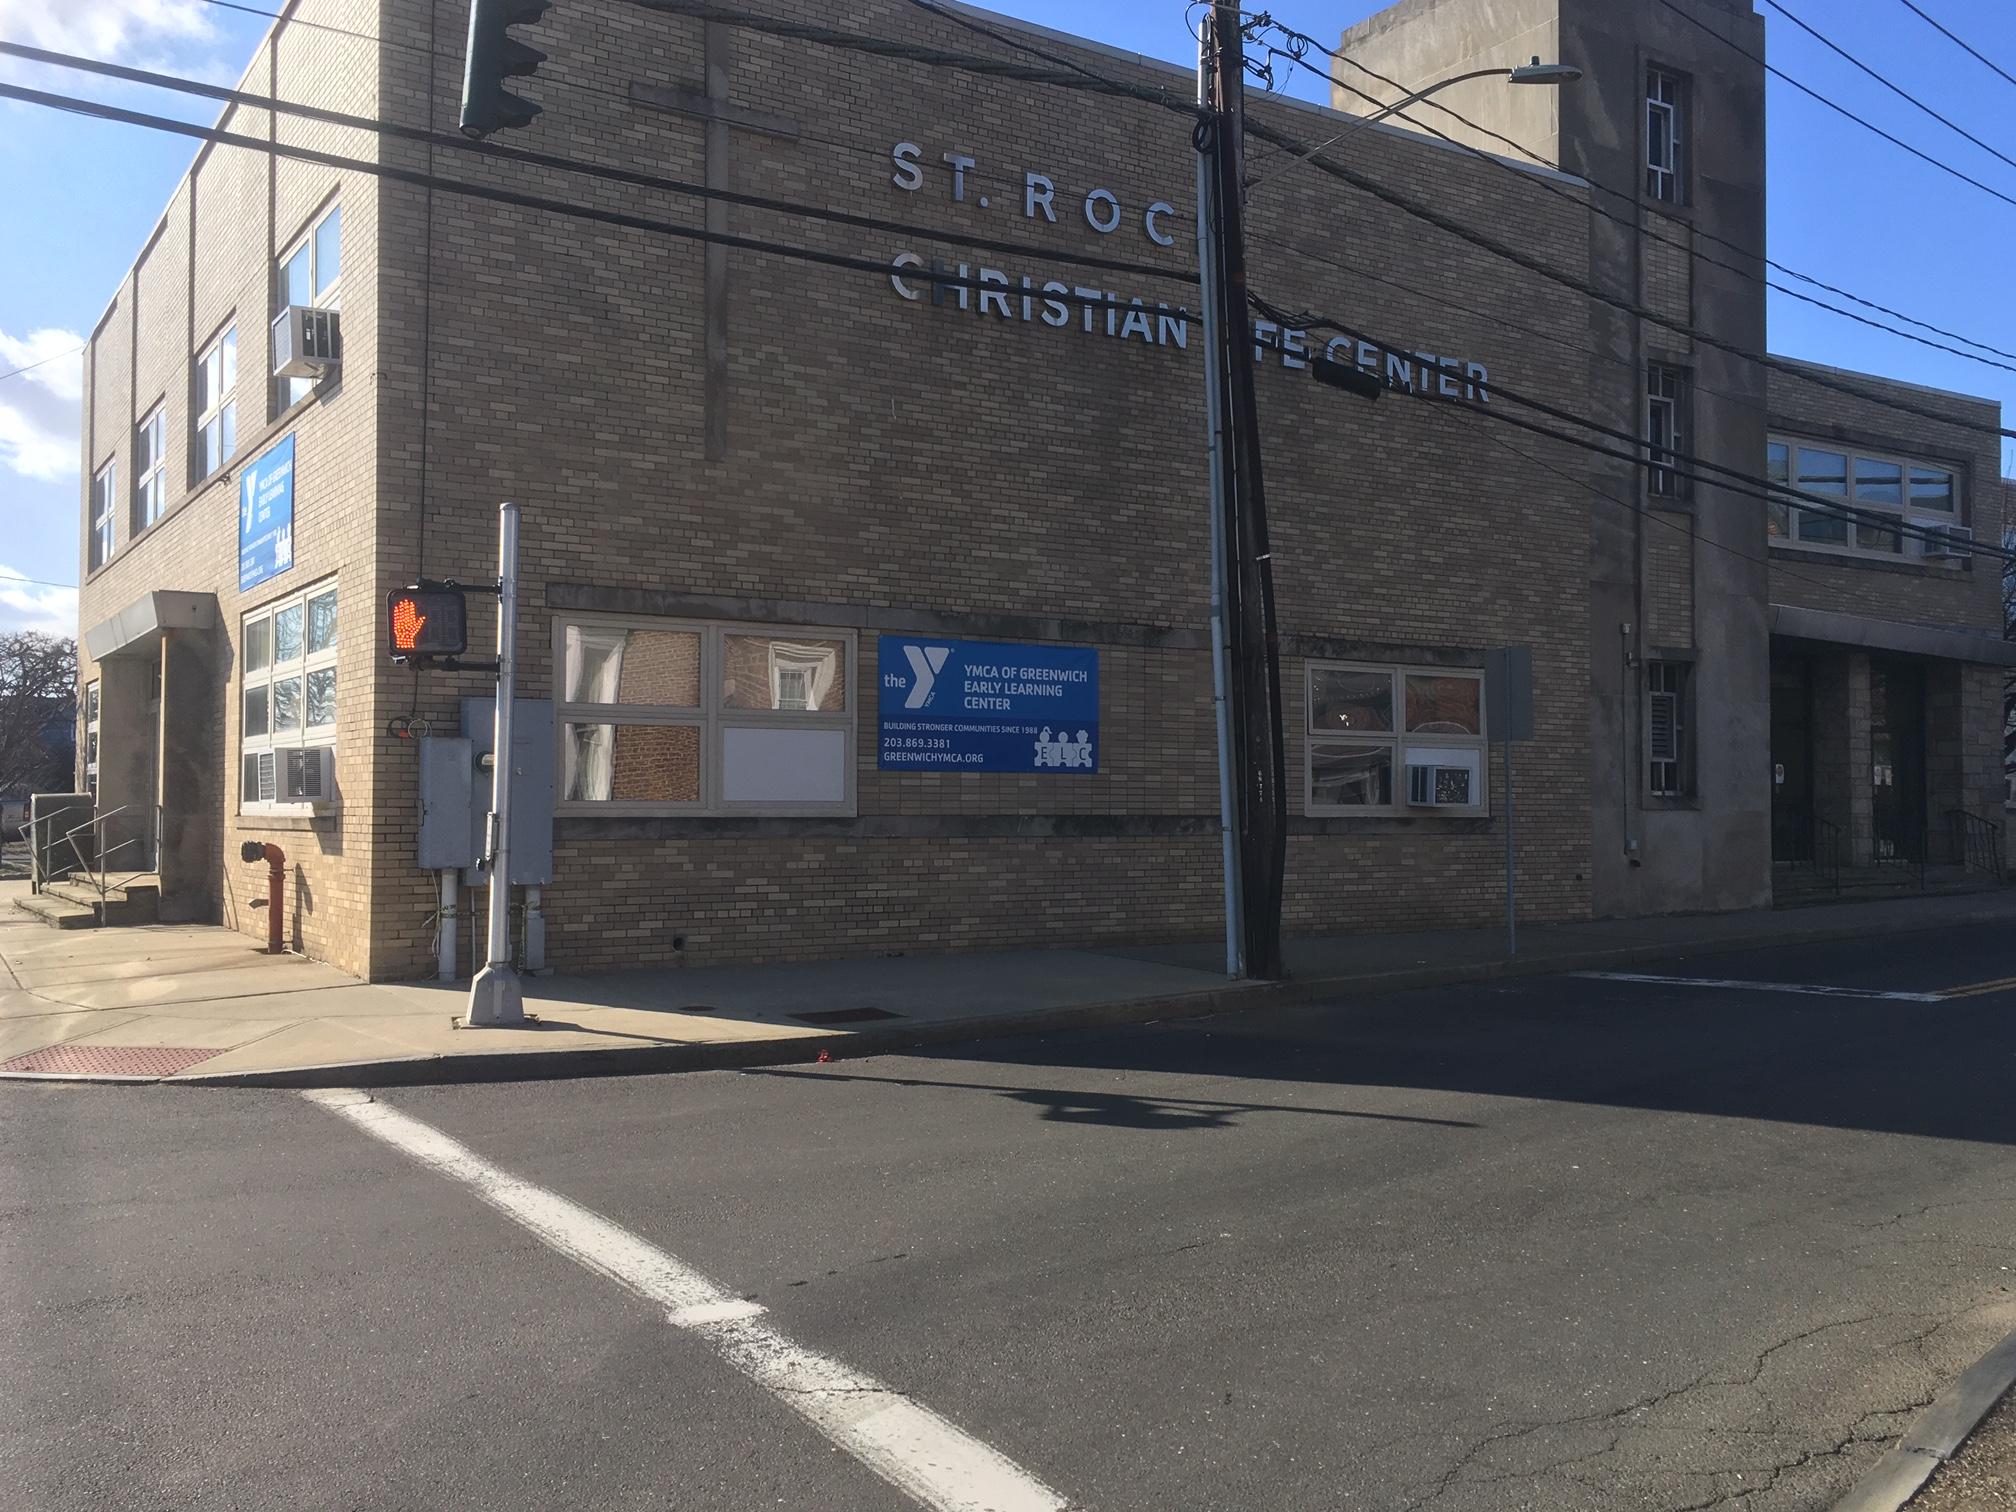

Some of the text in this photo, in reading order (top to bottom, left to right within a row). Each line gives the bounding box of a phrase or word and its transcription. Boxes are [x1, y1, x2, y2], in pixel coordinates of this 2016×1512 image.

[892, 142, 1175, 247] ST. ROC
[891, 252, 1490, 402] CHRISTIAN FE CENTER
[884, 673, 906, 688] the
[964, 664, 1088, 683] YMCA OF GREENWICH
[964, 680, 1063, 697] EARLY LEARNING
[964, 696, 1011, 711] CENTER
[884, 721, 916, 732] BUILDING
[917, 722, 953, 732] STRONGER
[954, 723, 1001, 734] COMMUNITIES
[1001, 725, 1020, 734] SINCE
[884, 737, 950, 748] 203.869.3381
[884, 752, 984, 763] GREENWICHYMCA.ORG
[1041, 746, 1087, 761] E L C
